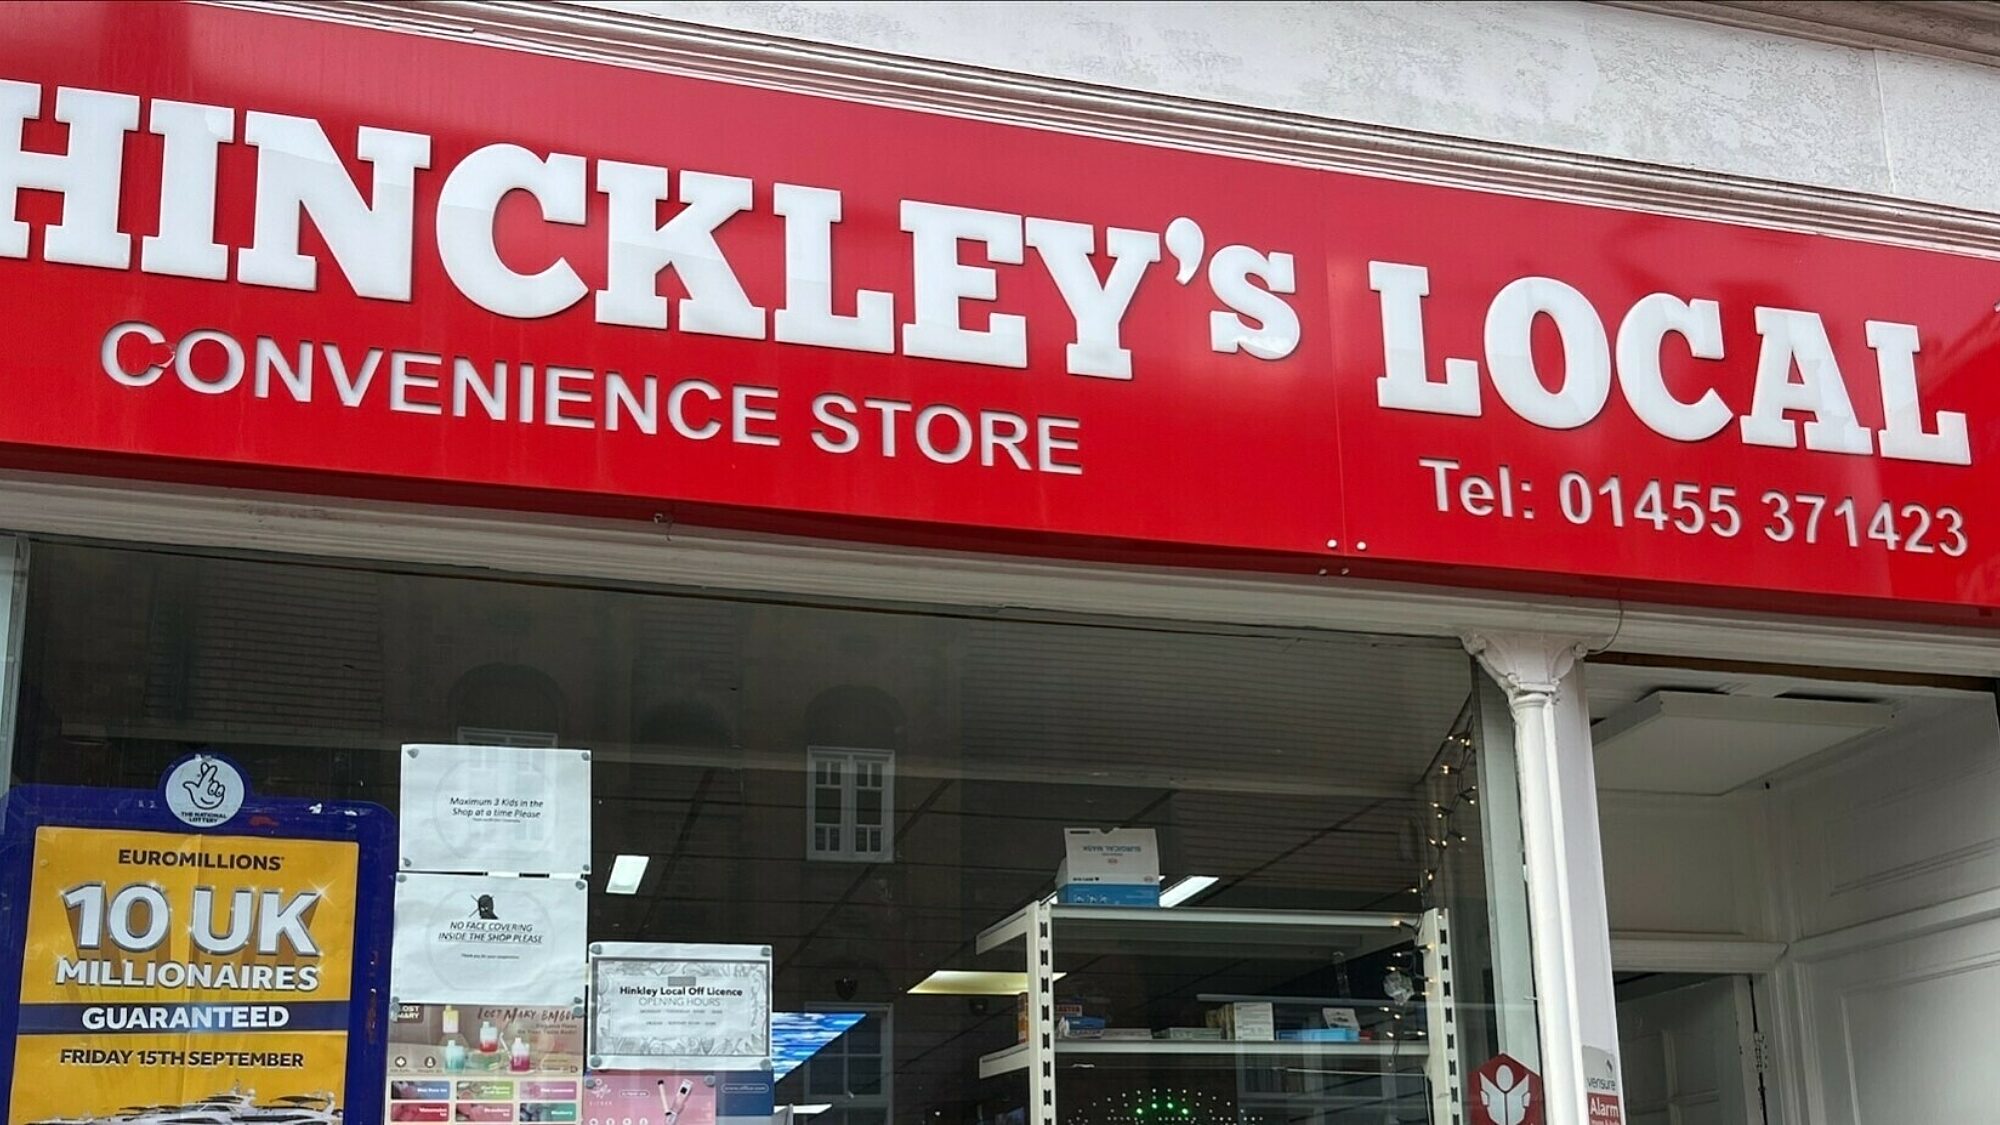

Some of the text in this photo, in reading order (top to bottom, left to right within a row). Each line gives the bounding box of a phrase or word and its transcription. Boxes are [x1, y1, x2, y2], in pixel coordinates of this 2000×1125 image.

[1368, 260, 1973, 465] LOCAL
[100, 321, 1083, 475] CONVENIENCE STORE
[1419, 457, 1969, 557] Tel: 01455 371423
[449, 797, 492, 806] Maximum
[501, 798, 518, 807] Kids
[520, 799, 528, 807] in
[529, 799, 543, 808] the
[452, 807, 541, 818] Shop at a time Please
[118, 849, 282, 870] EUROMILLIONS
[62, 881, 322, 957] 10 UK
[450, 921, 533, 932] NO FACE COVERING
[438, 931, 543, 943] INSIDE THE SHOP PLEASE
[55, 957, 320, 992] MILLIONAIRES
[620, 986, 743, 997] Hinkley Local Off Licence
[638, 997, 721, 1007] OPENING HOURS
[82, 1004, 290, 1030] GUARANTEED
[60, 1048, 304, 1069] FRIDAY 15TH SEPTEMBER
[1590, 1096, 1619, 1118] Alarm
